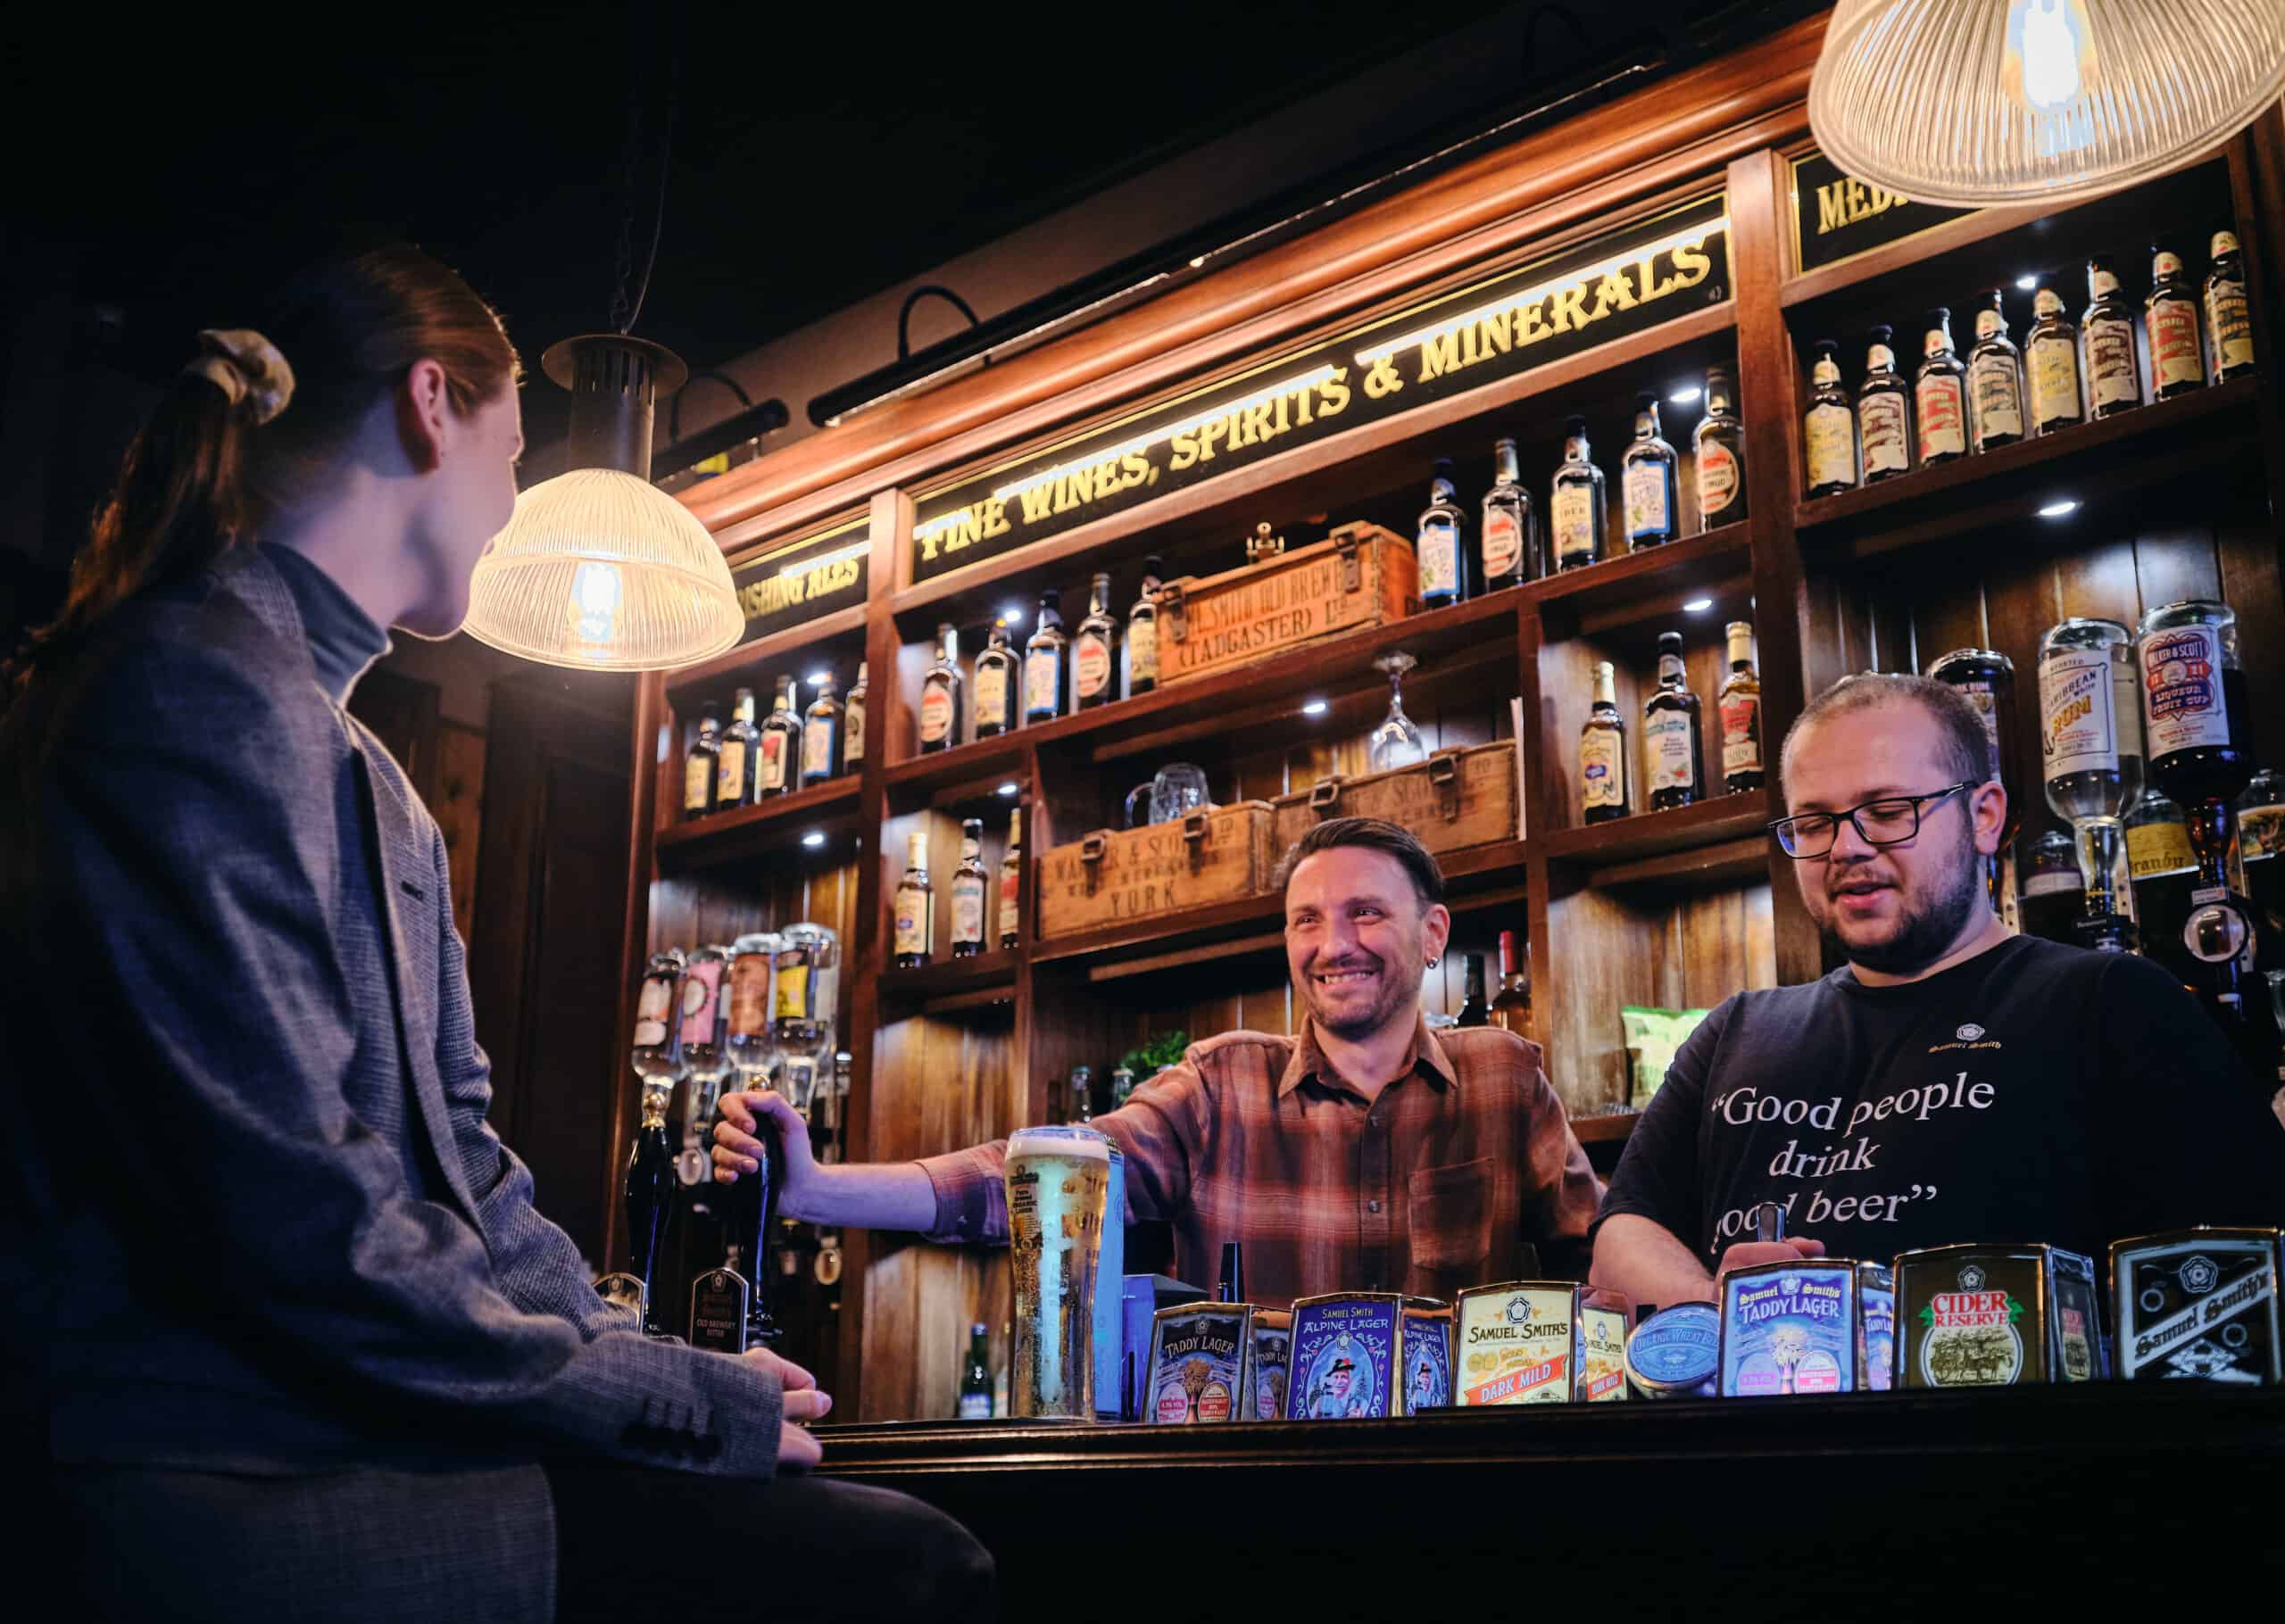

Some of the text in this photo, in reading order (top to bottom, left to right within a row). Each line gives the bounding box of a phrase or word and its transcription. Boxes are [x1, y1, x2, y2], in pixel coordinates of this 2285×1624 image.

[917, 235, 1712, 560] FINE WINES, SPIRITS & MINERALS
[2053, 694, 2093, 736] RUM
[1842, 1072, 1996, 1139] people
[1768, 1136, 1881, 1178] drink
[1739, 1285, 1779, 1305] Samuel
[1932, 1291, 2008, 1315] CIDER
[1322, 1306, 1374, 1319] SAMUEL SMITH
[1739, 1298, 1791, 1325] TADDY
[1791, 1297, 1840, 1318] LAGER
[1934, 1313, 2009, 1328] RESERVE
[1303, 1318, 1389, 1334] ALPINE LAGER
[1468, 1326, 1517, 1343] SAMUEL
[2134, 1305, 2199, 1361] Samuel
[1164, 1336, 1235, 1359] TADDY LAGER
[1481, 1362, 1552, 1404] DARK MILD
